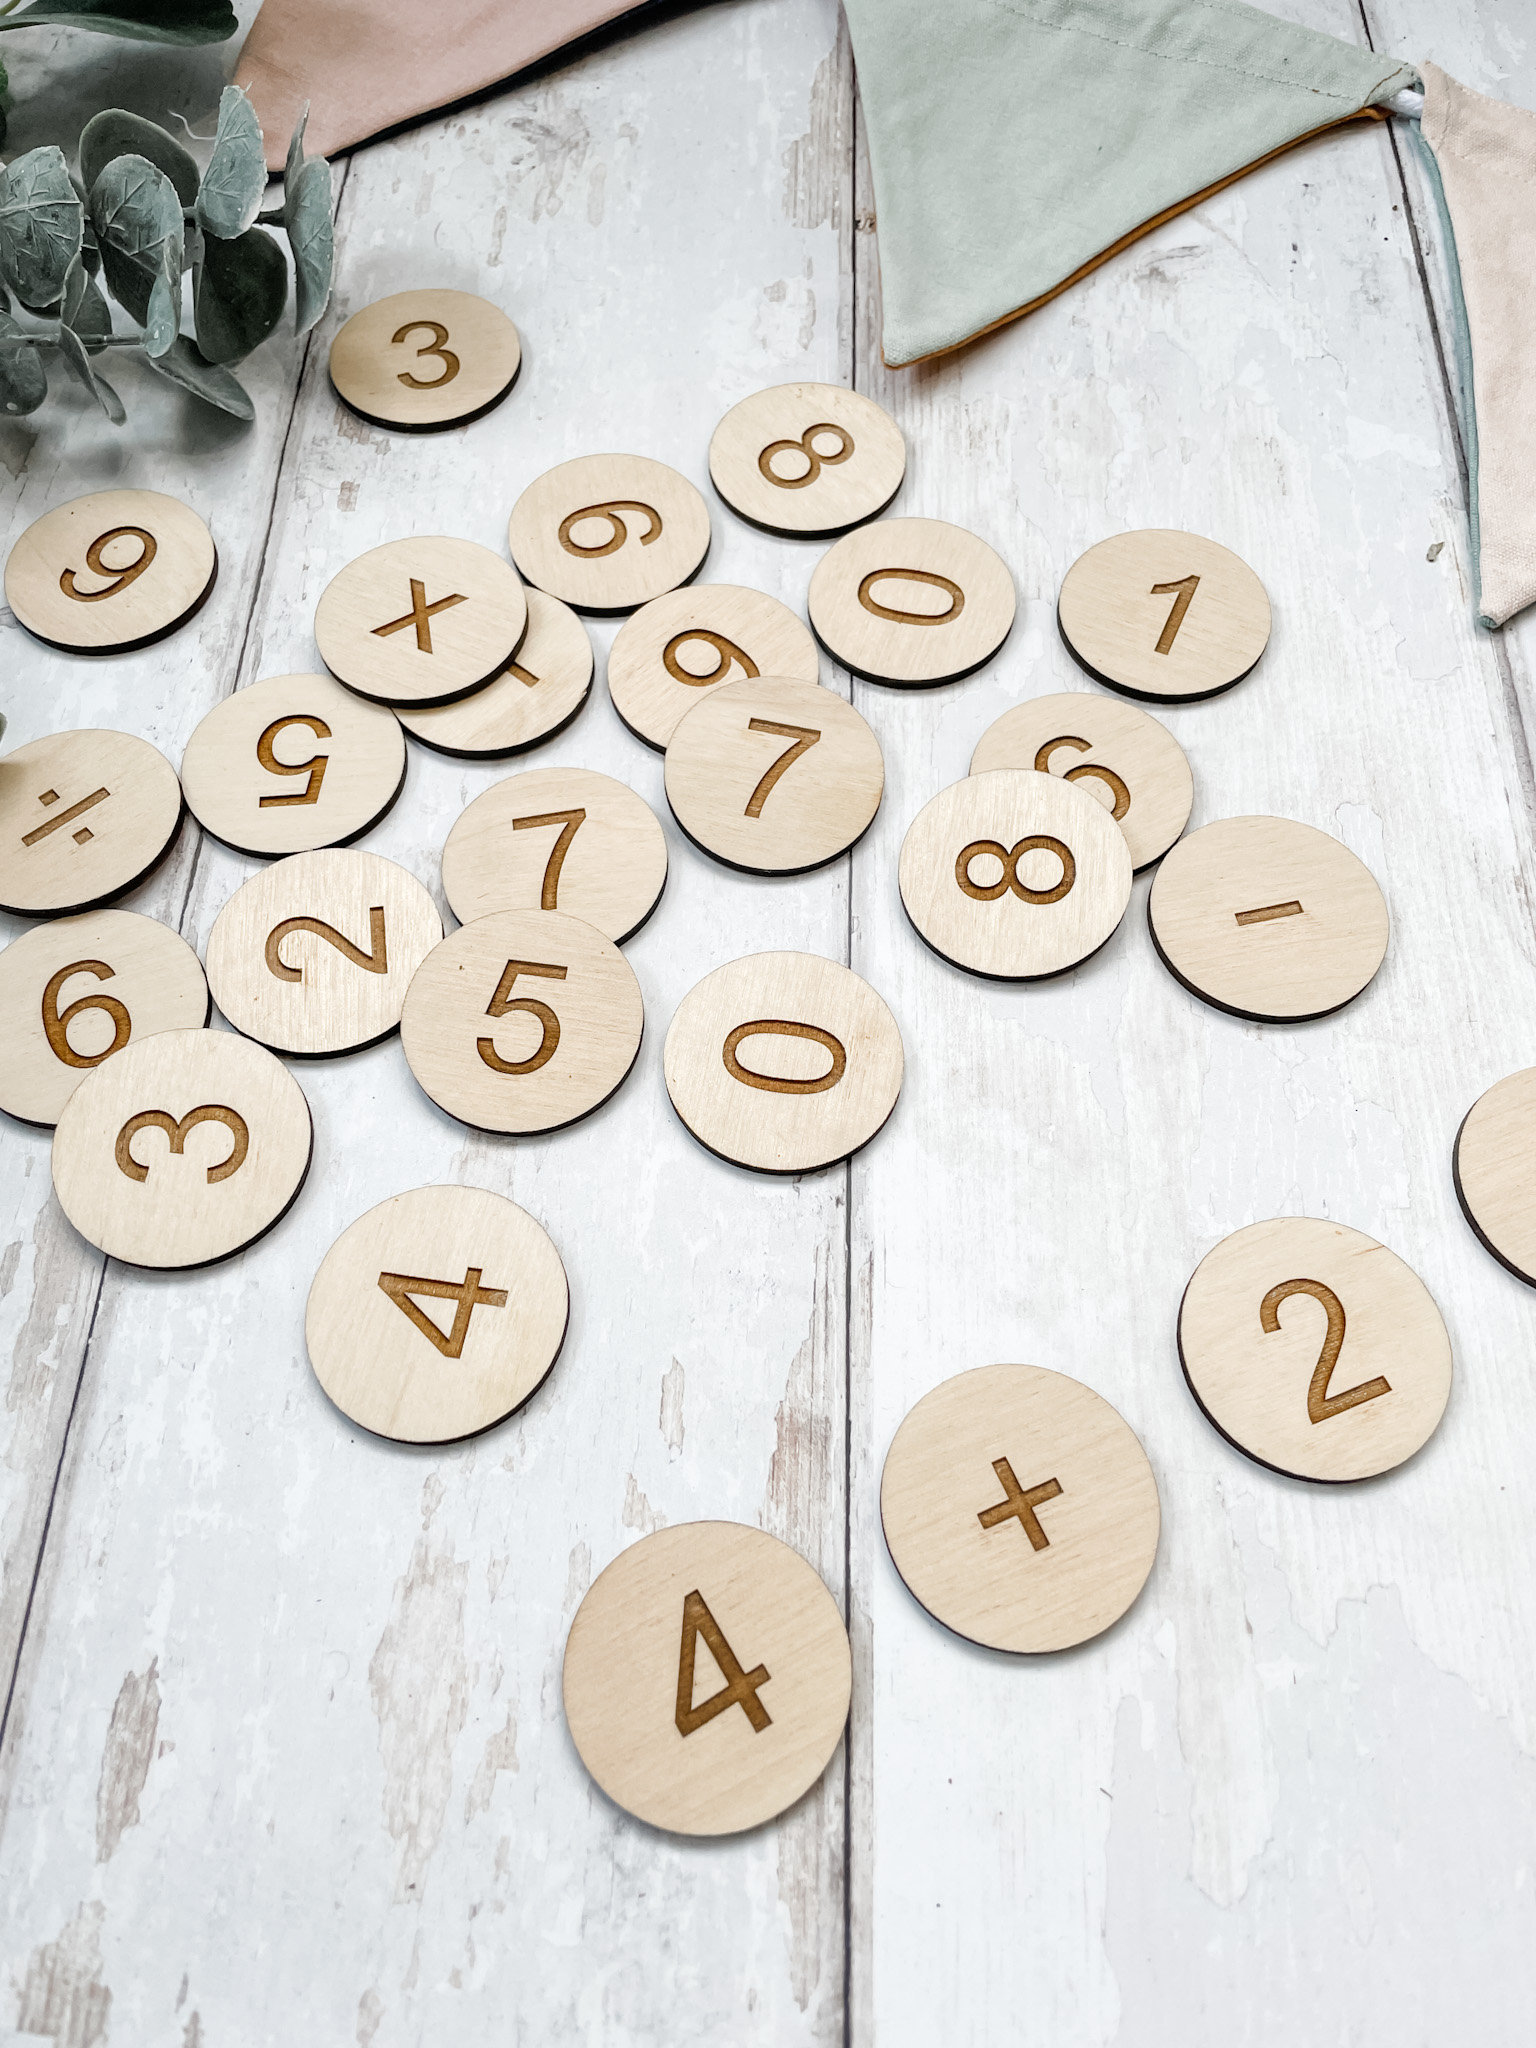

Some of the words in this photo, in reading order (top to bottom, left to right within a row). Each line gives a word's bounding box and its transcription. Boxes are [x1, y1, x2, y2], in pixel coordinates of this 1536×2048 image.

[391, 320, 461, 390] 3
[758, 422, 855, 490] 8
[857, 567, 965, 626] 0
[1149, 574, 1201, 655] 1
[256, 714, 332, 808] 5
[743, 717, 822, 819] 7
[512, 807, 587, 911] 7
[954, 834, 1076, 905] 8
[264, 906, 388, 983] 2
[41, 959, 132, 1069] 6
[476, 959, 568, 1076] 5
[722, 1019, 847, 1095] 0
[114, 1104, 250, 1184] 3
[377, 1266, 509, 1360] 4
[1259, 1278, 1393, 1425] 2
[674, 1589, 773, 1737] 4
